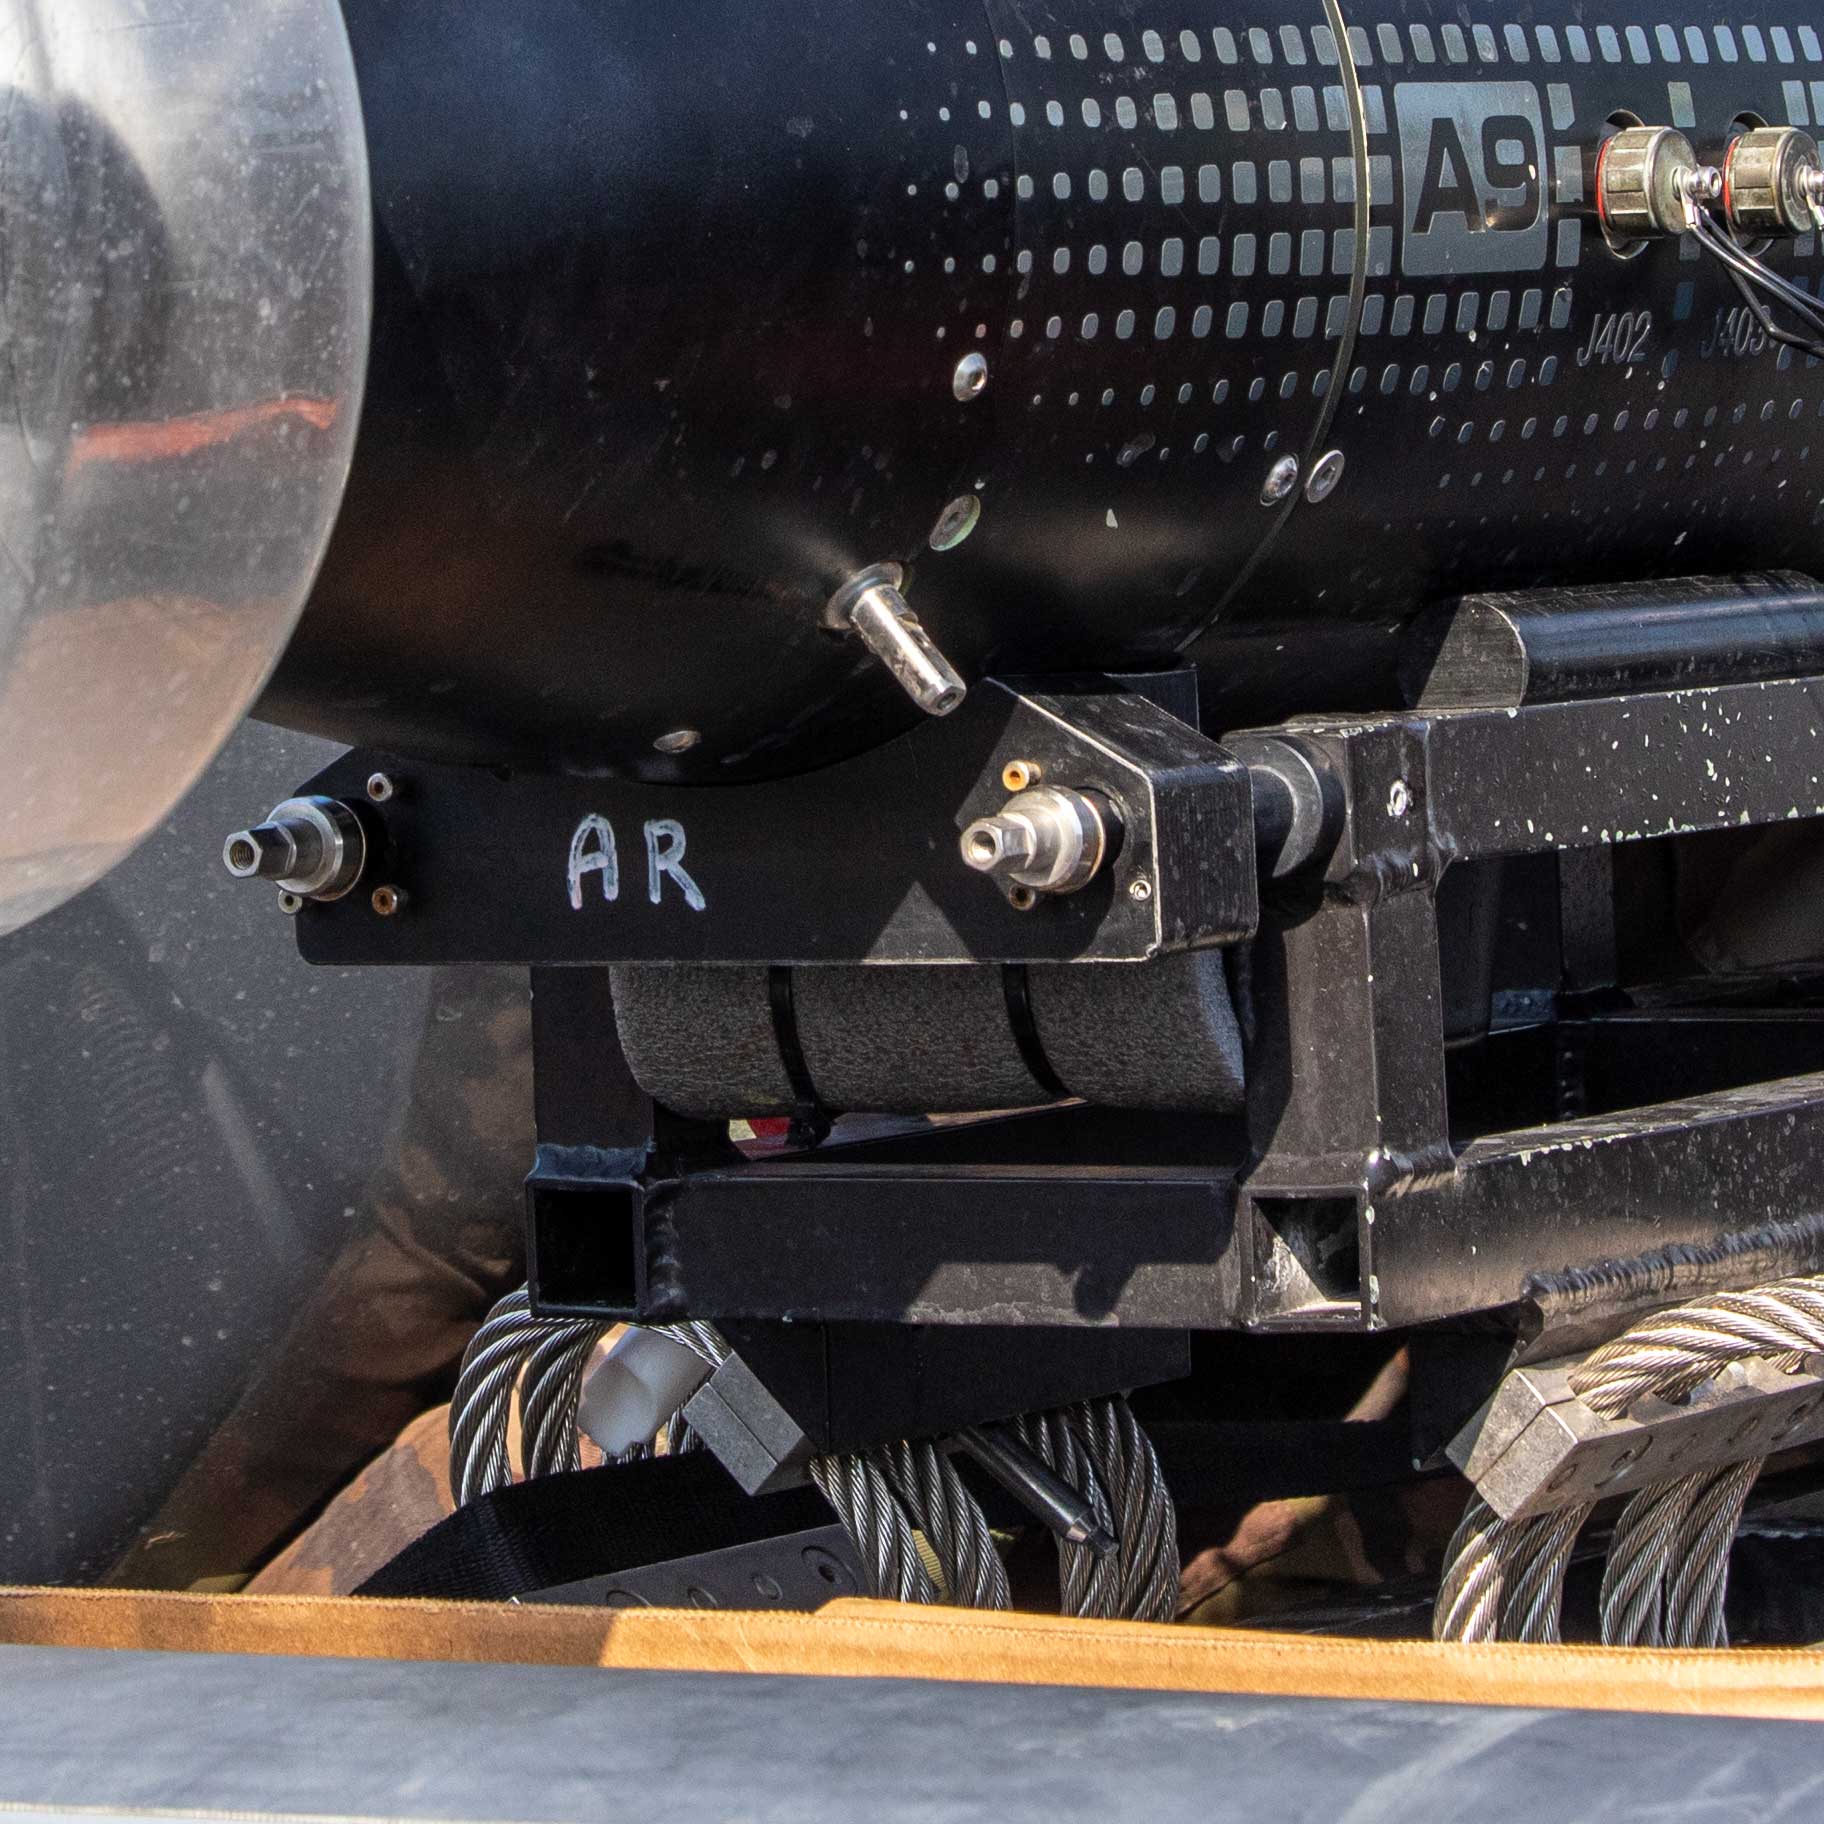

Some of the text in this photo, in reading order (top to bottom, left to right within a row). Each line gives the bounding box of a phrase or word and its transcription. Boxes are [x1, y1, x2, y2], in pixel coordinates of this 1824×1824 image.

[1411, 114, 1542, 235] A9
[1577, 310, 1653, 368] J402
[567, 813, 707, 911] AR
